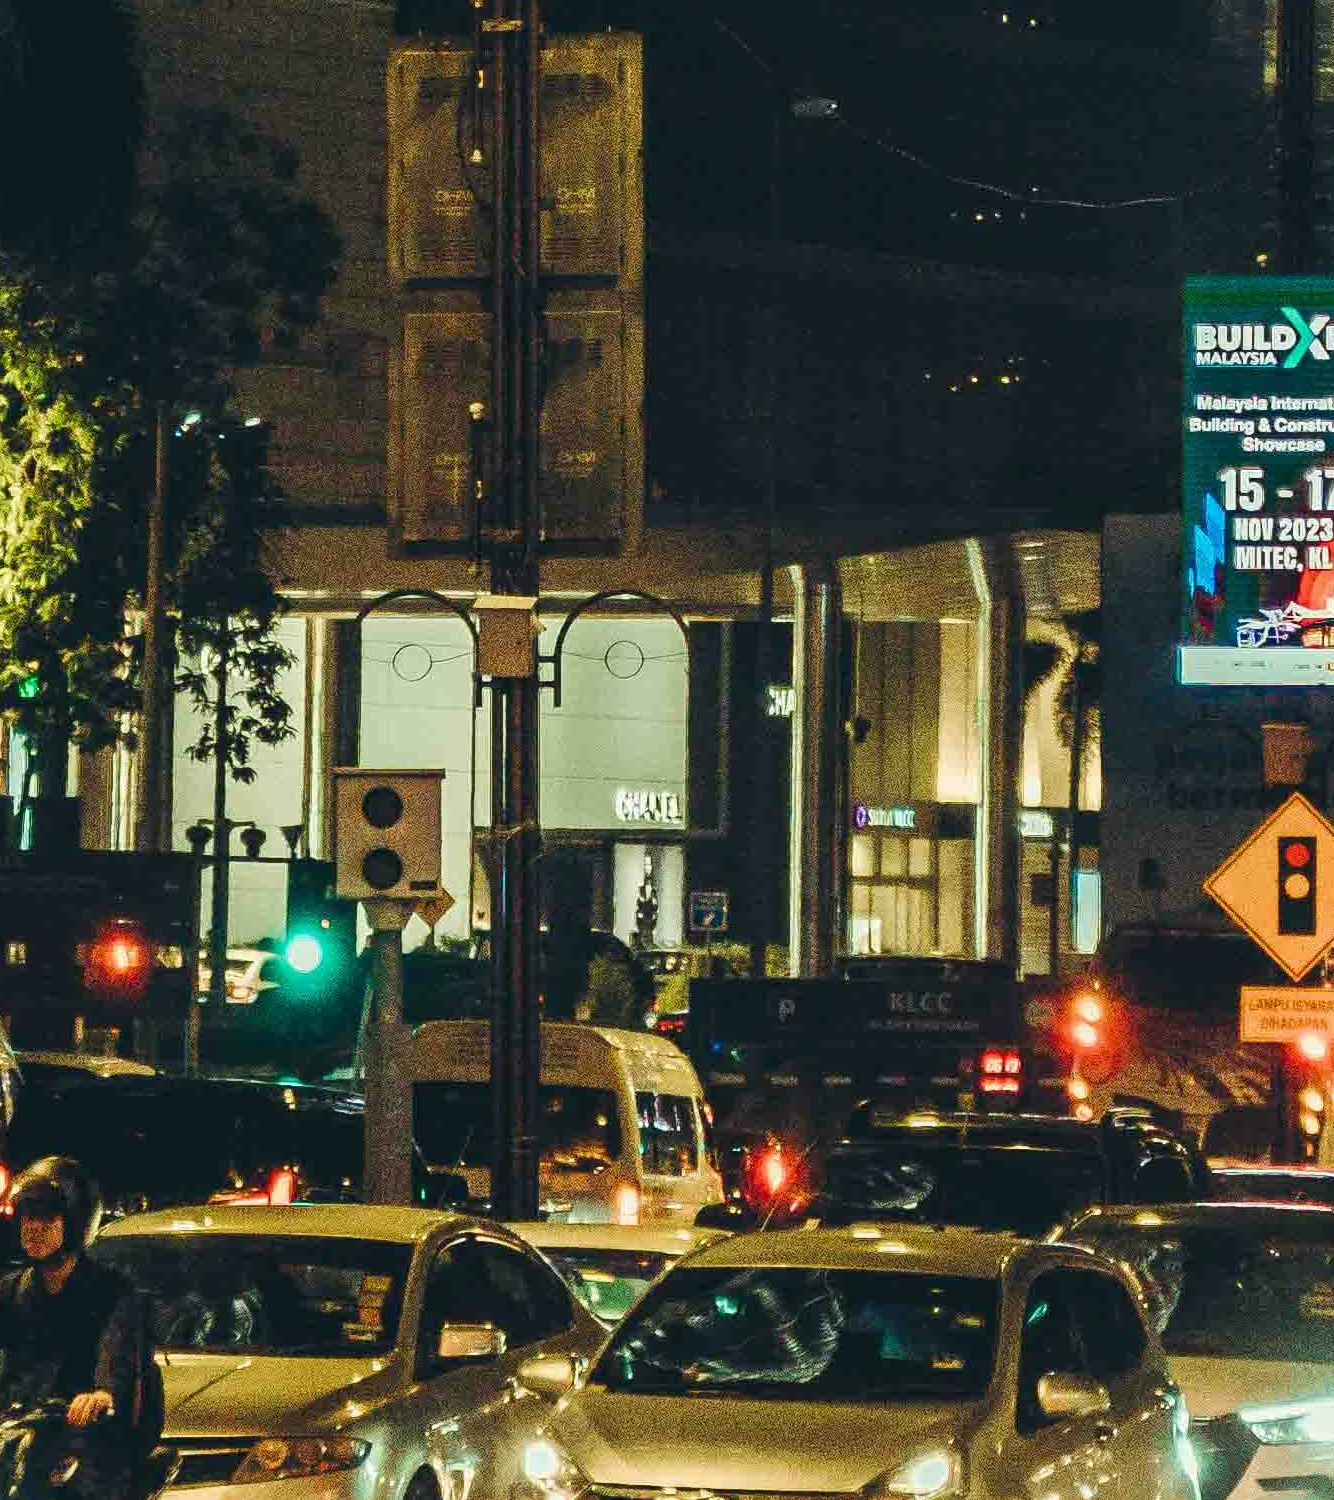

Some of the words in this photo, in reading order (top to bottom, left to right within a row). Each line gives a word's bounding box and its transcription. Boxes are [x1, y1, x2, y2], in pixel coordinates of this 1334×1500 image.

[1195, 351, 1278, 366] MALAYSIA
[1196, 395, 1268, 413] Malaysia
[1189, 417, 1254, 435] Building
[1258, 418, 1271, 432] &
[1242, 437, 1326, 452] Showcase
[1220, 467, 1265, 511] 15
[1234, 518, 1274, 542] NOV
[1279, 518, 1334, 542] 2023
[1234, 546, 1304, 572] MITEC,
[1308, 546, 1333, 570] KL
